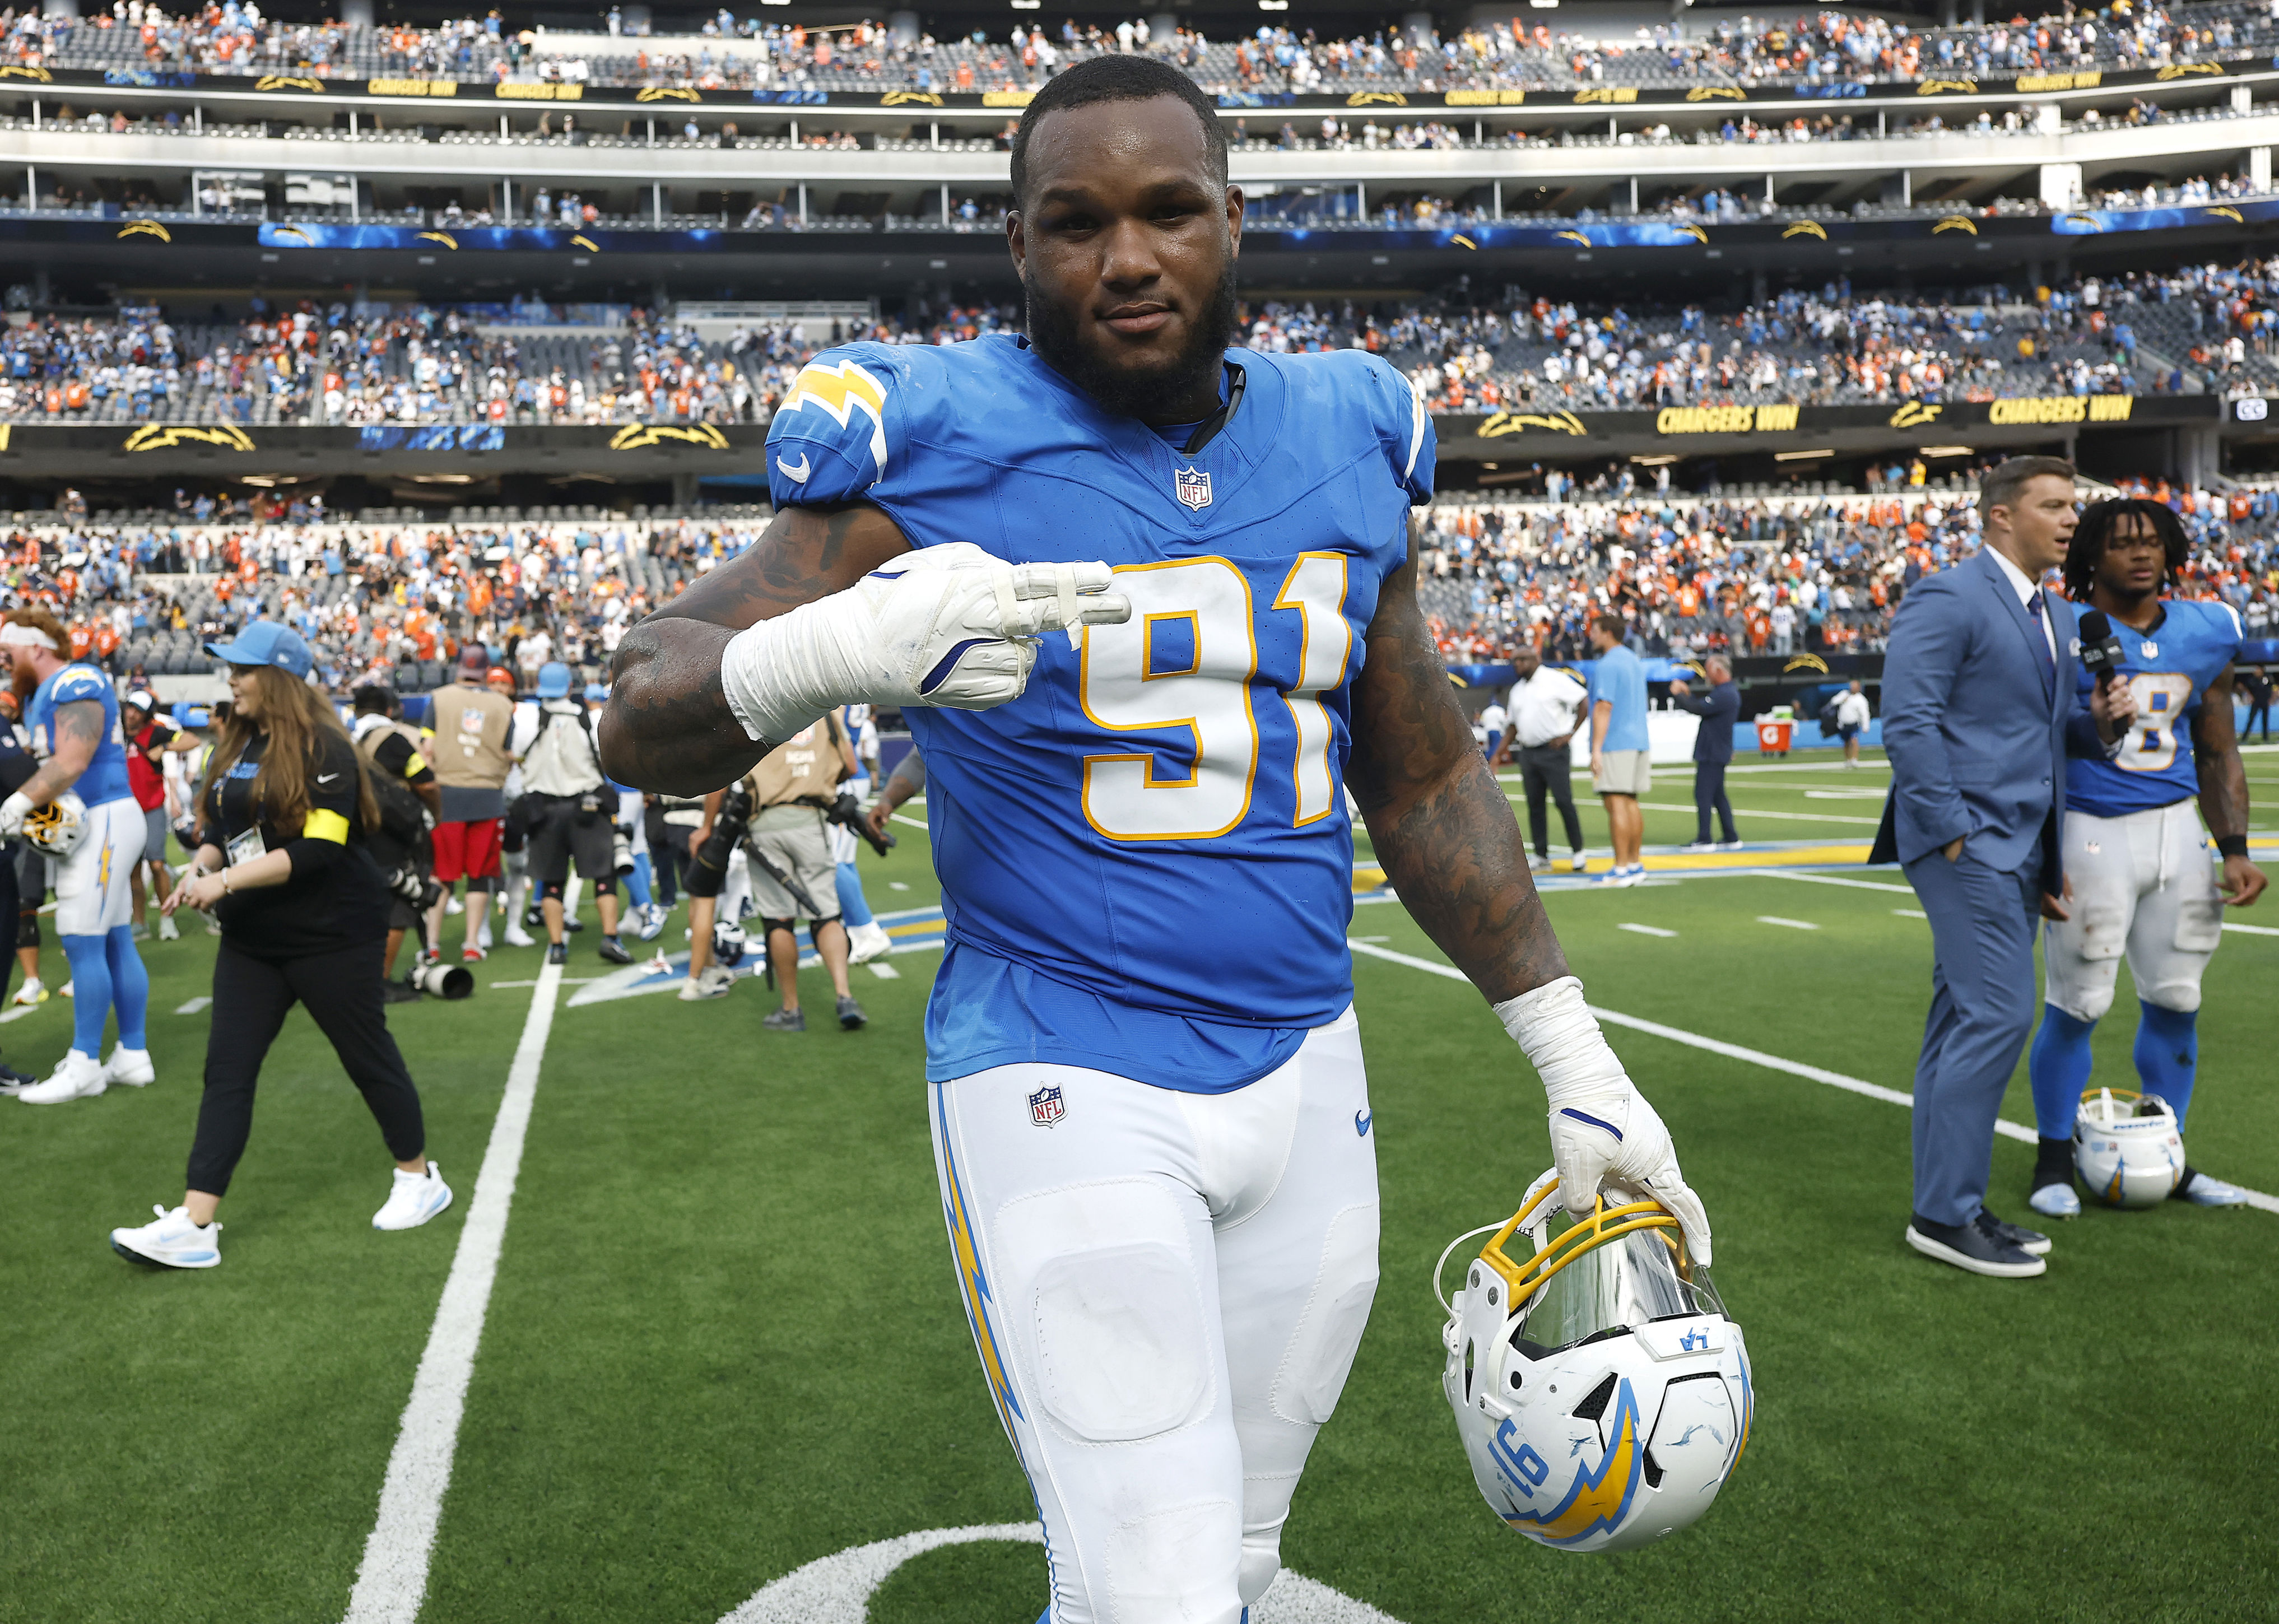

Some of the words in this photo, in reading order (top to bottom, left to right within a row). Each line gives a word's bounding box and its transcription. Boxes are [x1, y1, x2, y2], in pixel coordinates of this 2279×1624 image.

[1657, 406, 1755, 434] CHARGERS
[1755, 404, 1799, 431] WIN
[1989, 395, 2089, 425] CHARGERS
[2089, 394, 2133, 421] WIN
[1182, 485, 1207, 502] NFL
[1079, 551, 1352, 841] 91
[1762, 725, 1779, 745] G
[2114, 673, 2193, 771] 8
[1035, 1101, 1062, 1119] NFL
[1680, 1327, 1708, 1351] LA
